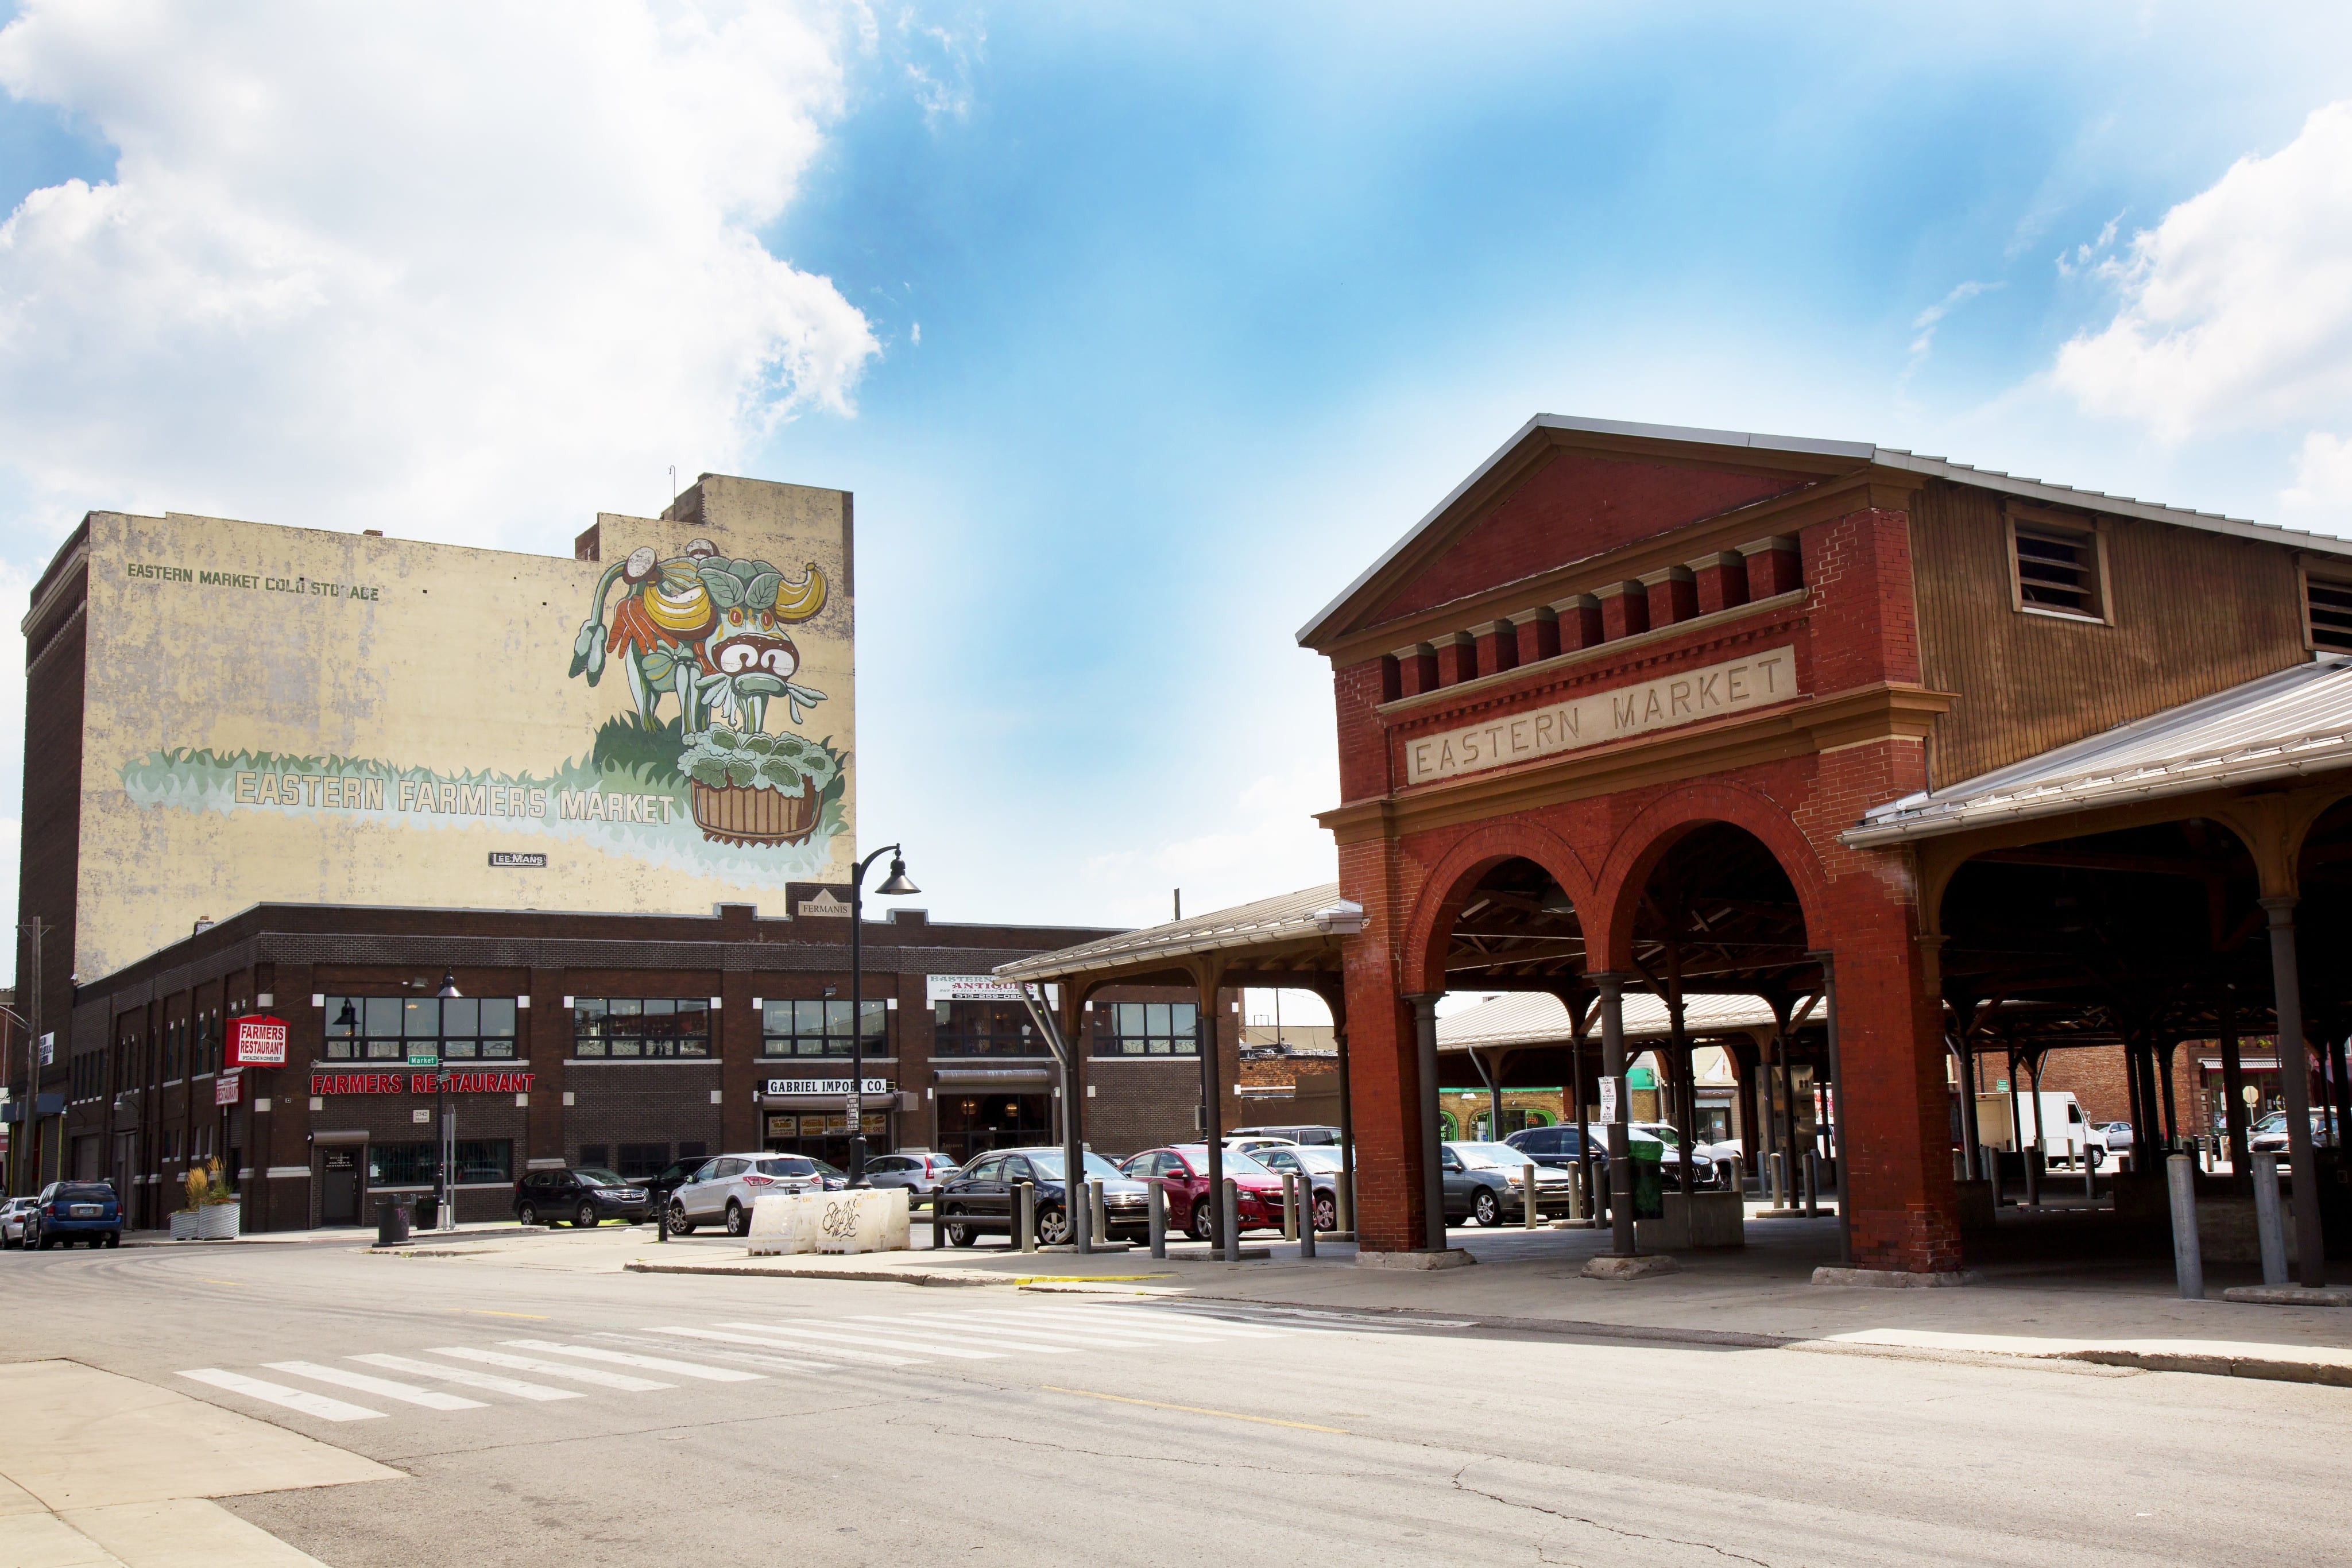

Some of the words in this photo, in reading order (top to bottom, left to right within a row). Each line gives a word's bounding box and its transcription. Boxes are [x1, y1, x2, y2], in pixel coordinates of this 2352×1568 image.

[128, 563, 193, 583] EASTERN
[199, 570, 260, 590] MARKET
[265, 577, 305, 594] COLD
[311, 582, 379, 602] STOAGE
[1415, 707, 1580, 775] EASTERN
[1613, 657, 1782, 730] MARKET
[234, 771, 384, 811] EASTERN
[398, 780, 547, 818] FARMERS
[560, 789, 675, 824] MARKET
[803, 905, 848, 913] FERMANIS
[952, 982, 1034, 990] ANTIQUS
[241, 1025, 284, 1040] FARMERS
[240, 1040, 284, 1055] RESTAURANT
[311, 1074, 403, 1095] FARMERS
[771, 1081, 818, 1093] GABRIEL
[822, 1081, 862, 1092] IMPO
[867, 1081, 885, 1091] CO.
[217, 1086, 239, 1102] RESTAURANT
